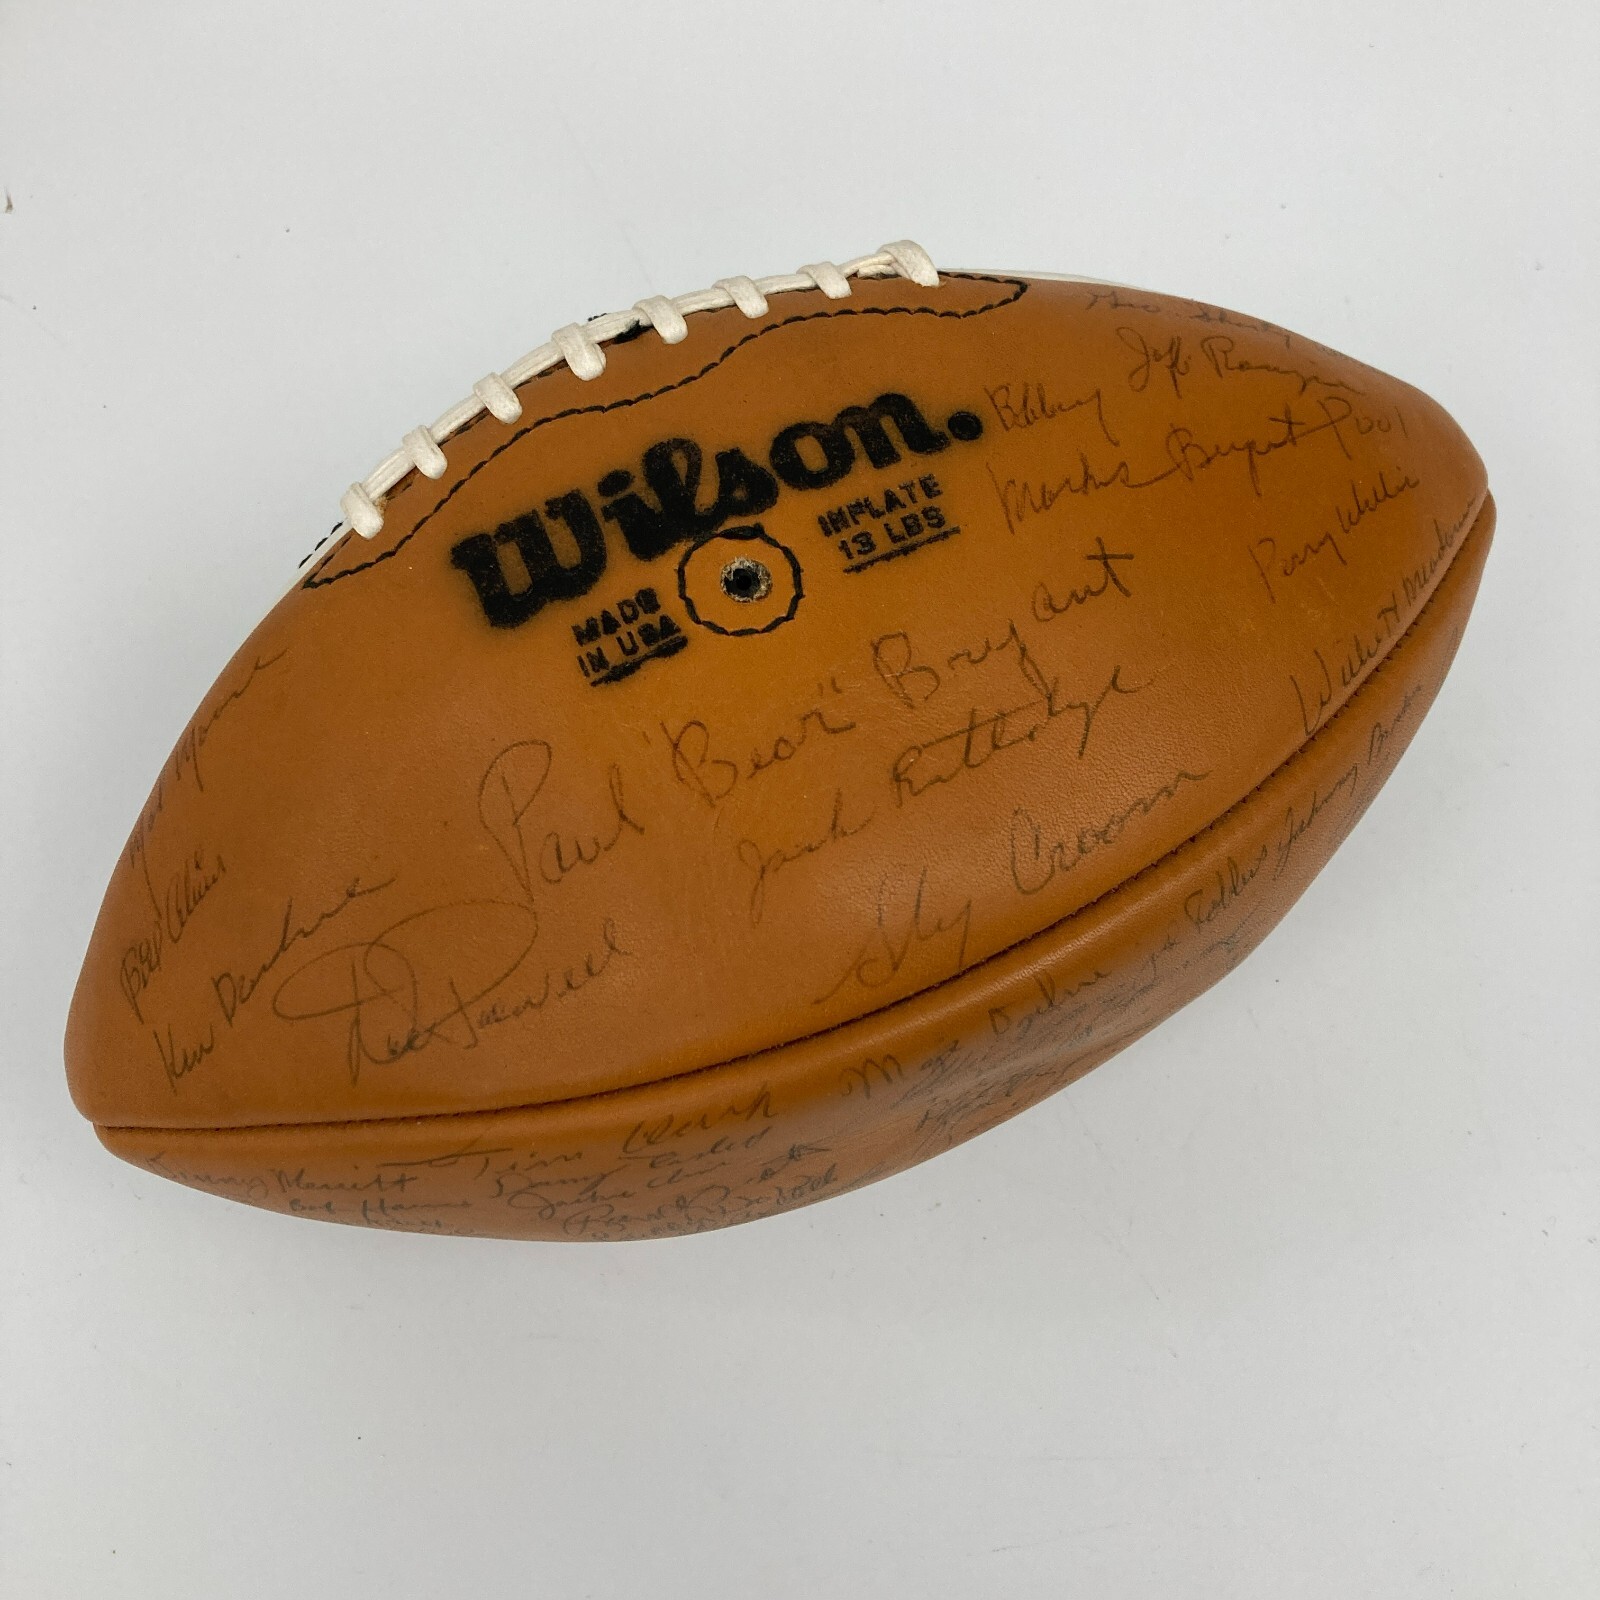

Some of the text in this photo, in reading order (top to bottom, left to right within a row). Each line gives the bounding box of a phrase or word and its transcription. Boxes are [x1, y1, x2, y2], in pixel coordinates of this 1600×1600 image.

[816, 474, 943, 539] INFLATE
[837, 506, 947, 560] 13 LBS
[571, 586, 661, 648] MADE
[576, 613, 681, 678] IN USA
[477, 738, 646, 902] Paul
